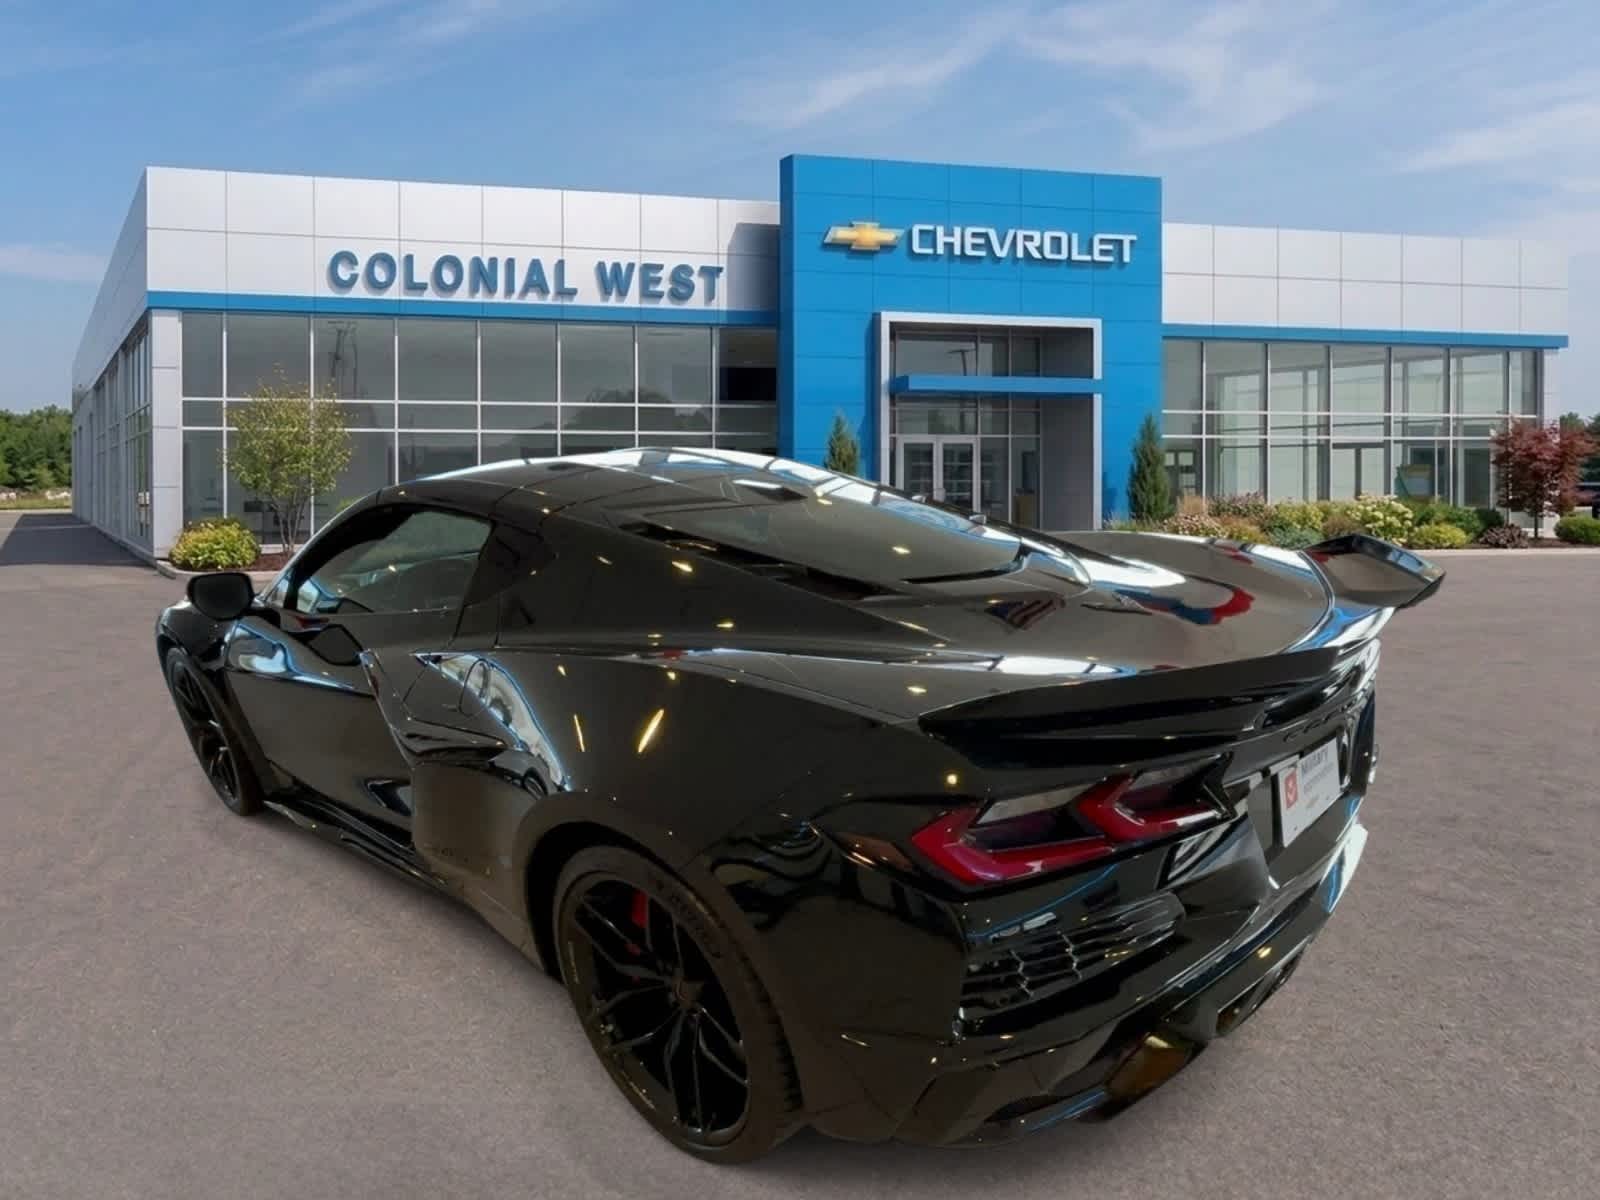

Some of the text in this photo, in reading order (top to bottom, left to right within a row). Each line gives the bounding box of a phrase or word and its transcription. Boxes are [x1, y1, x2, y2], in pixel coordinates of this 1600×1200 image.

[911, 223, 1138, 263] CHEVROLET
[328, 250, 724, 302] COLONIAL WEST
